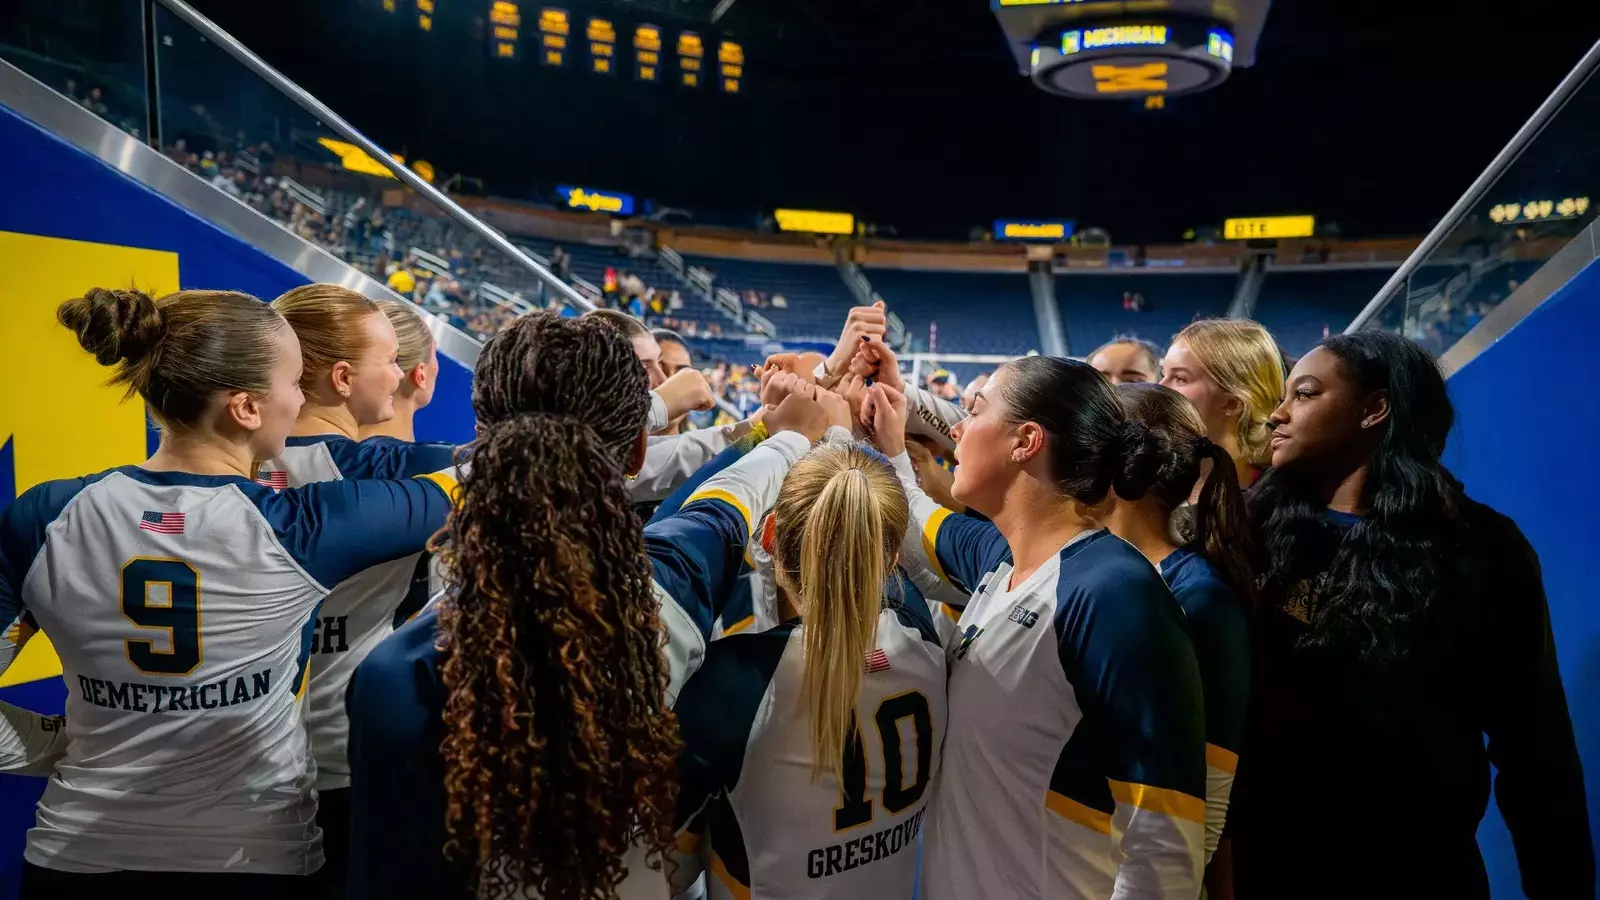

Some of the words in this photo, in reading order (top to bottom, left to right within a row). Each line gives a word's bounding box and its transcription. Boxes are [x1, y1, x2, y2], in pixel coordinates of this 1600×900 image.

[916, 405, 953, 441] MICHI
[119, 555, 204, 677] 9
[77, 668, 272, 714] DEMETRICIAN
[832, 688, 933, 834] 10
